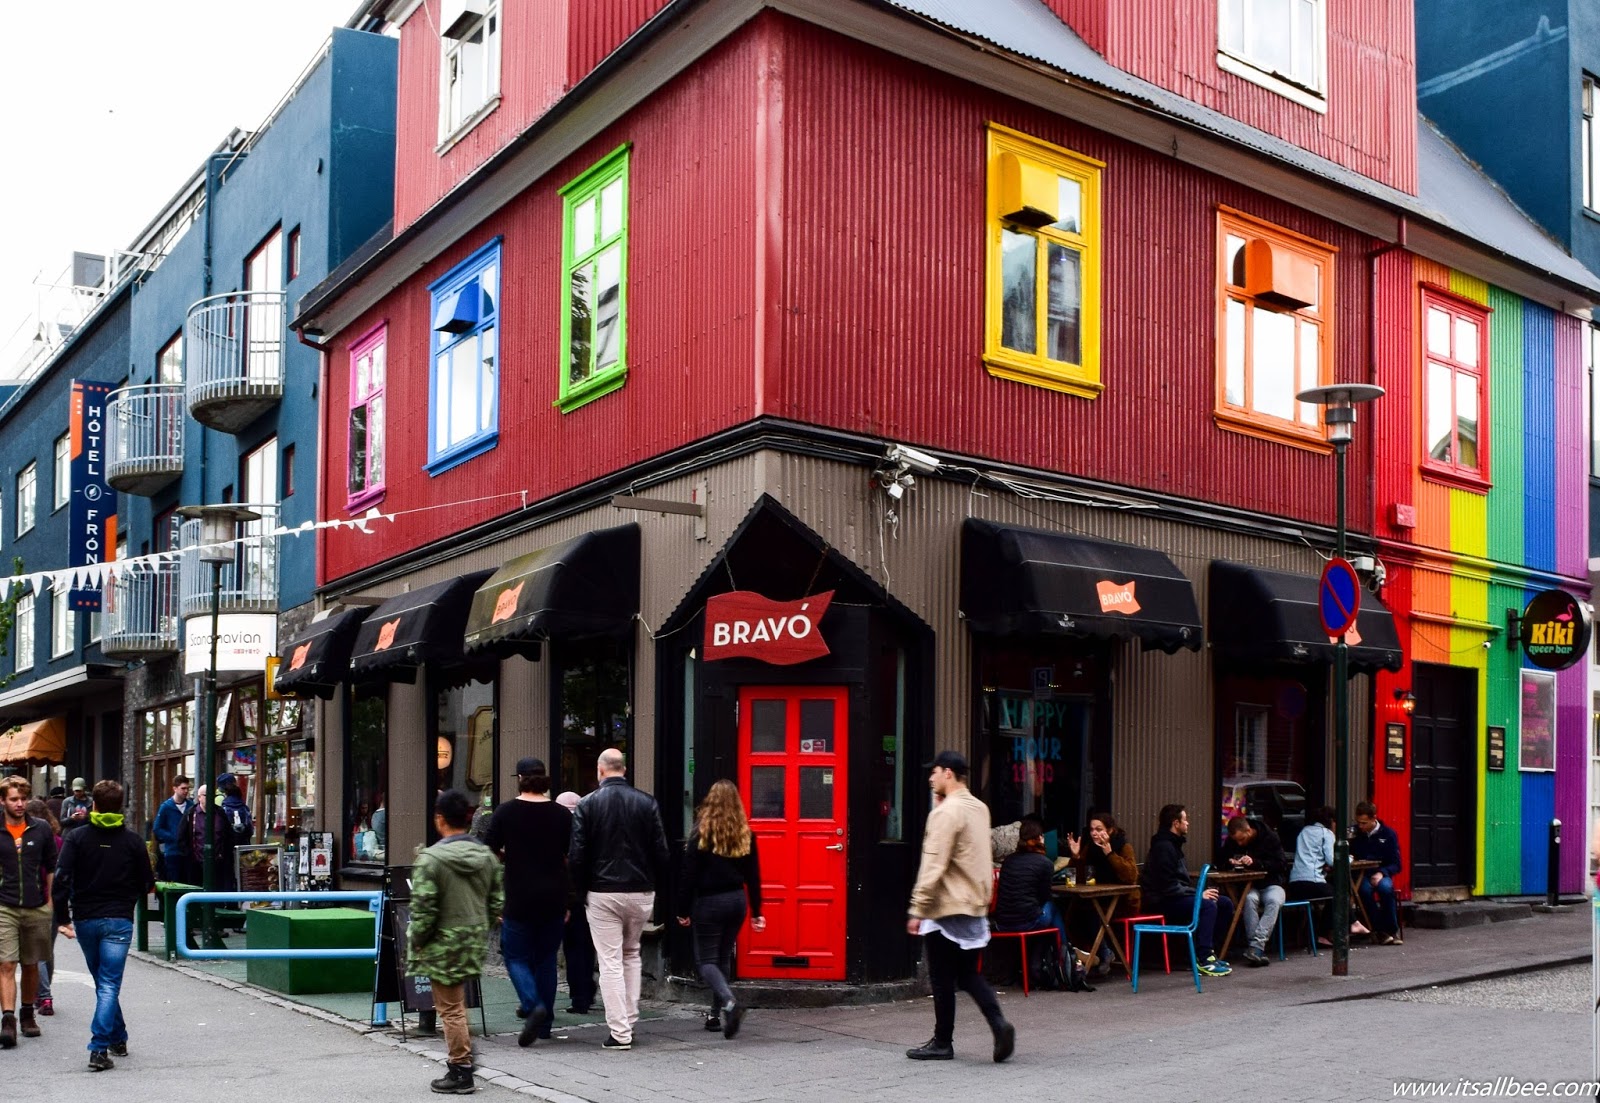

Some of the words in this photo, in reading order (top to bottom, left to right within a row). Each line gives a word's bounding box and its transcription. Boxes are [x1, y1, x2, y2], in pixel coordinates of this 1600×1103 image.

[87, 405, 101, 475] HÓTEL
[85, 509, 99, 564] FRÓN
[1101, 587, 1132, 606] BRAVÓ
[713, 602, 812, 646] BRAVÓ
[1530, 620, 1575, 646] Kiki
[190, 631, 262, 647] Scandnavian
[1528, 645, 1555, 655] queer
[1555, 645, 1573, 654] bar
[1003, 698, 1067, 728] HAPPY
[1013, 736, 1062, 761] HOUR
